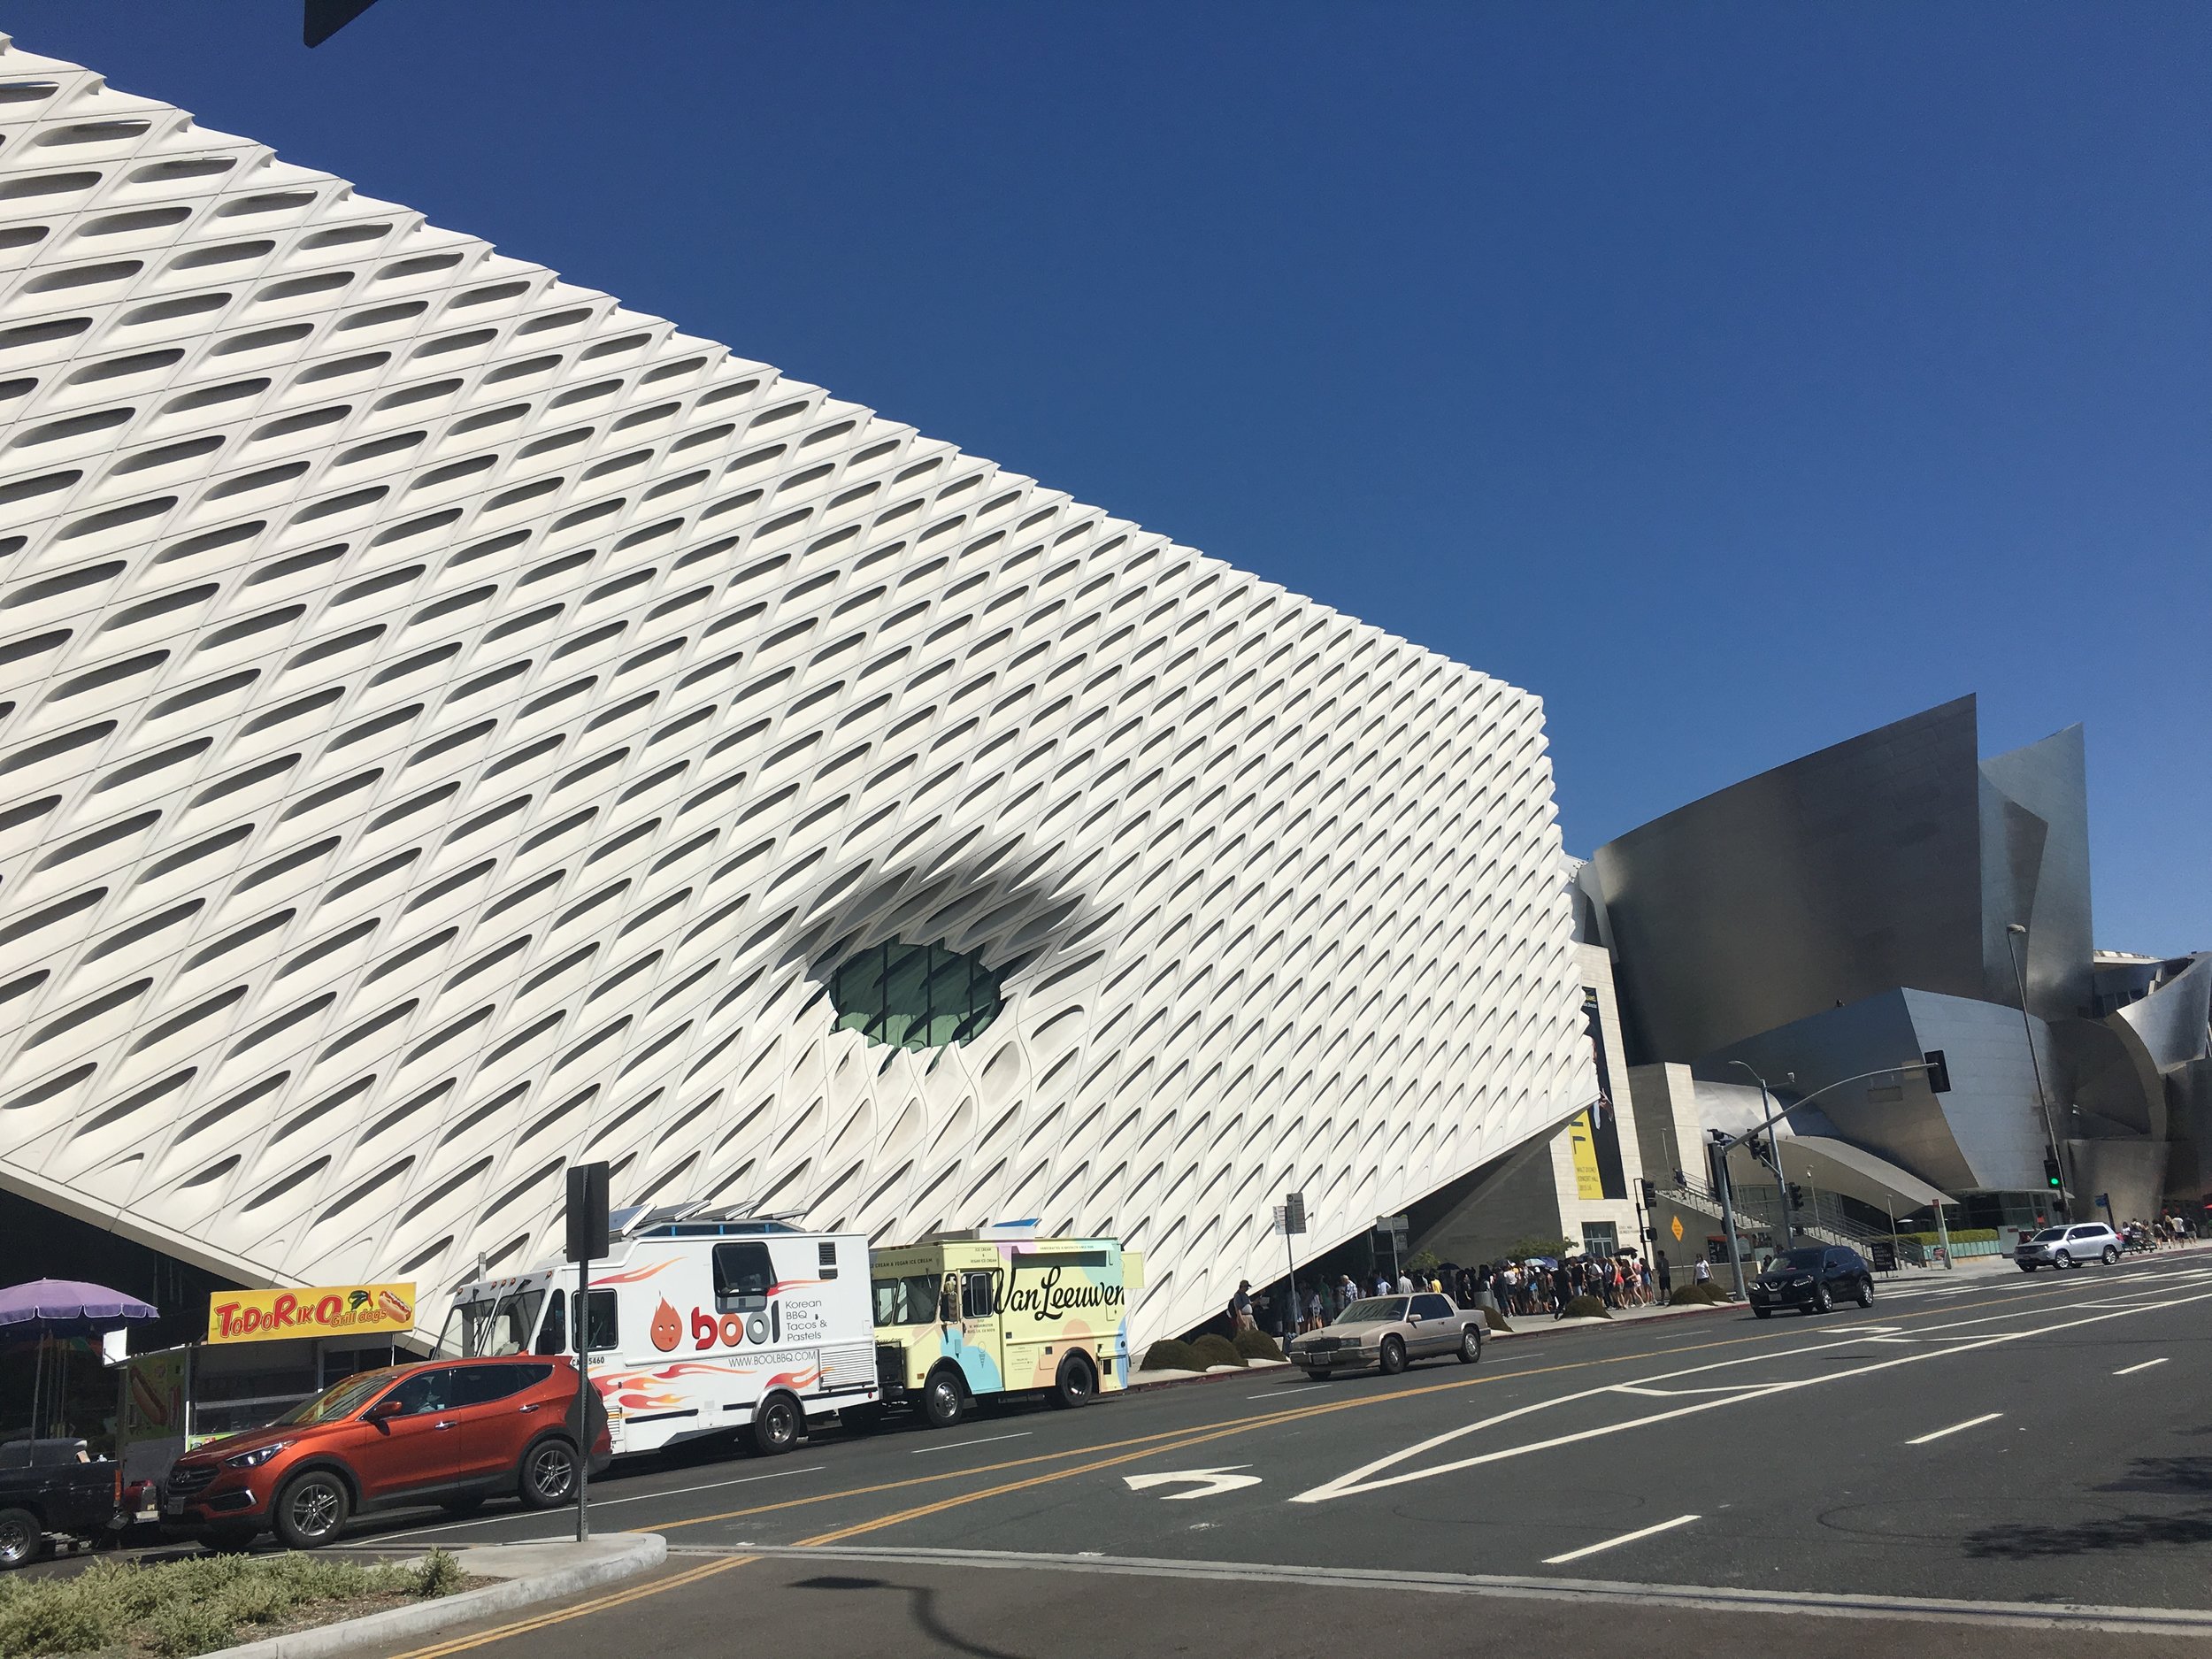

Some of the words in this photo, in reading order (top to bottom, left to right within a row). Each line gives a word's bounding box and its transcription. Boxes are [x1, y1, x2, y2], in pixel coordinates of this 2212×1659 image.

[990, 1267, 1041, 1314] Van
[1034, 1265, 1125, 1321] Leeuwen
[785, 1300, 822, 1309] Korean
[330, 1310, 356, 1327] Grill
[358, 1308, 388, 1325] dogs
[787, 1310, 807, 1320] BBQ
[691, 1300, 780, 1350] bool
[787, 1321, 817, 1331] Tacos
[819, 1319, 827, 1328] &
[787, 1331, 822, 1341] Pastels
[728, 1350, 816, 1367] WWW.BOOLBBQ.COM
